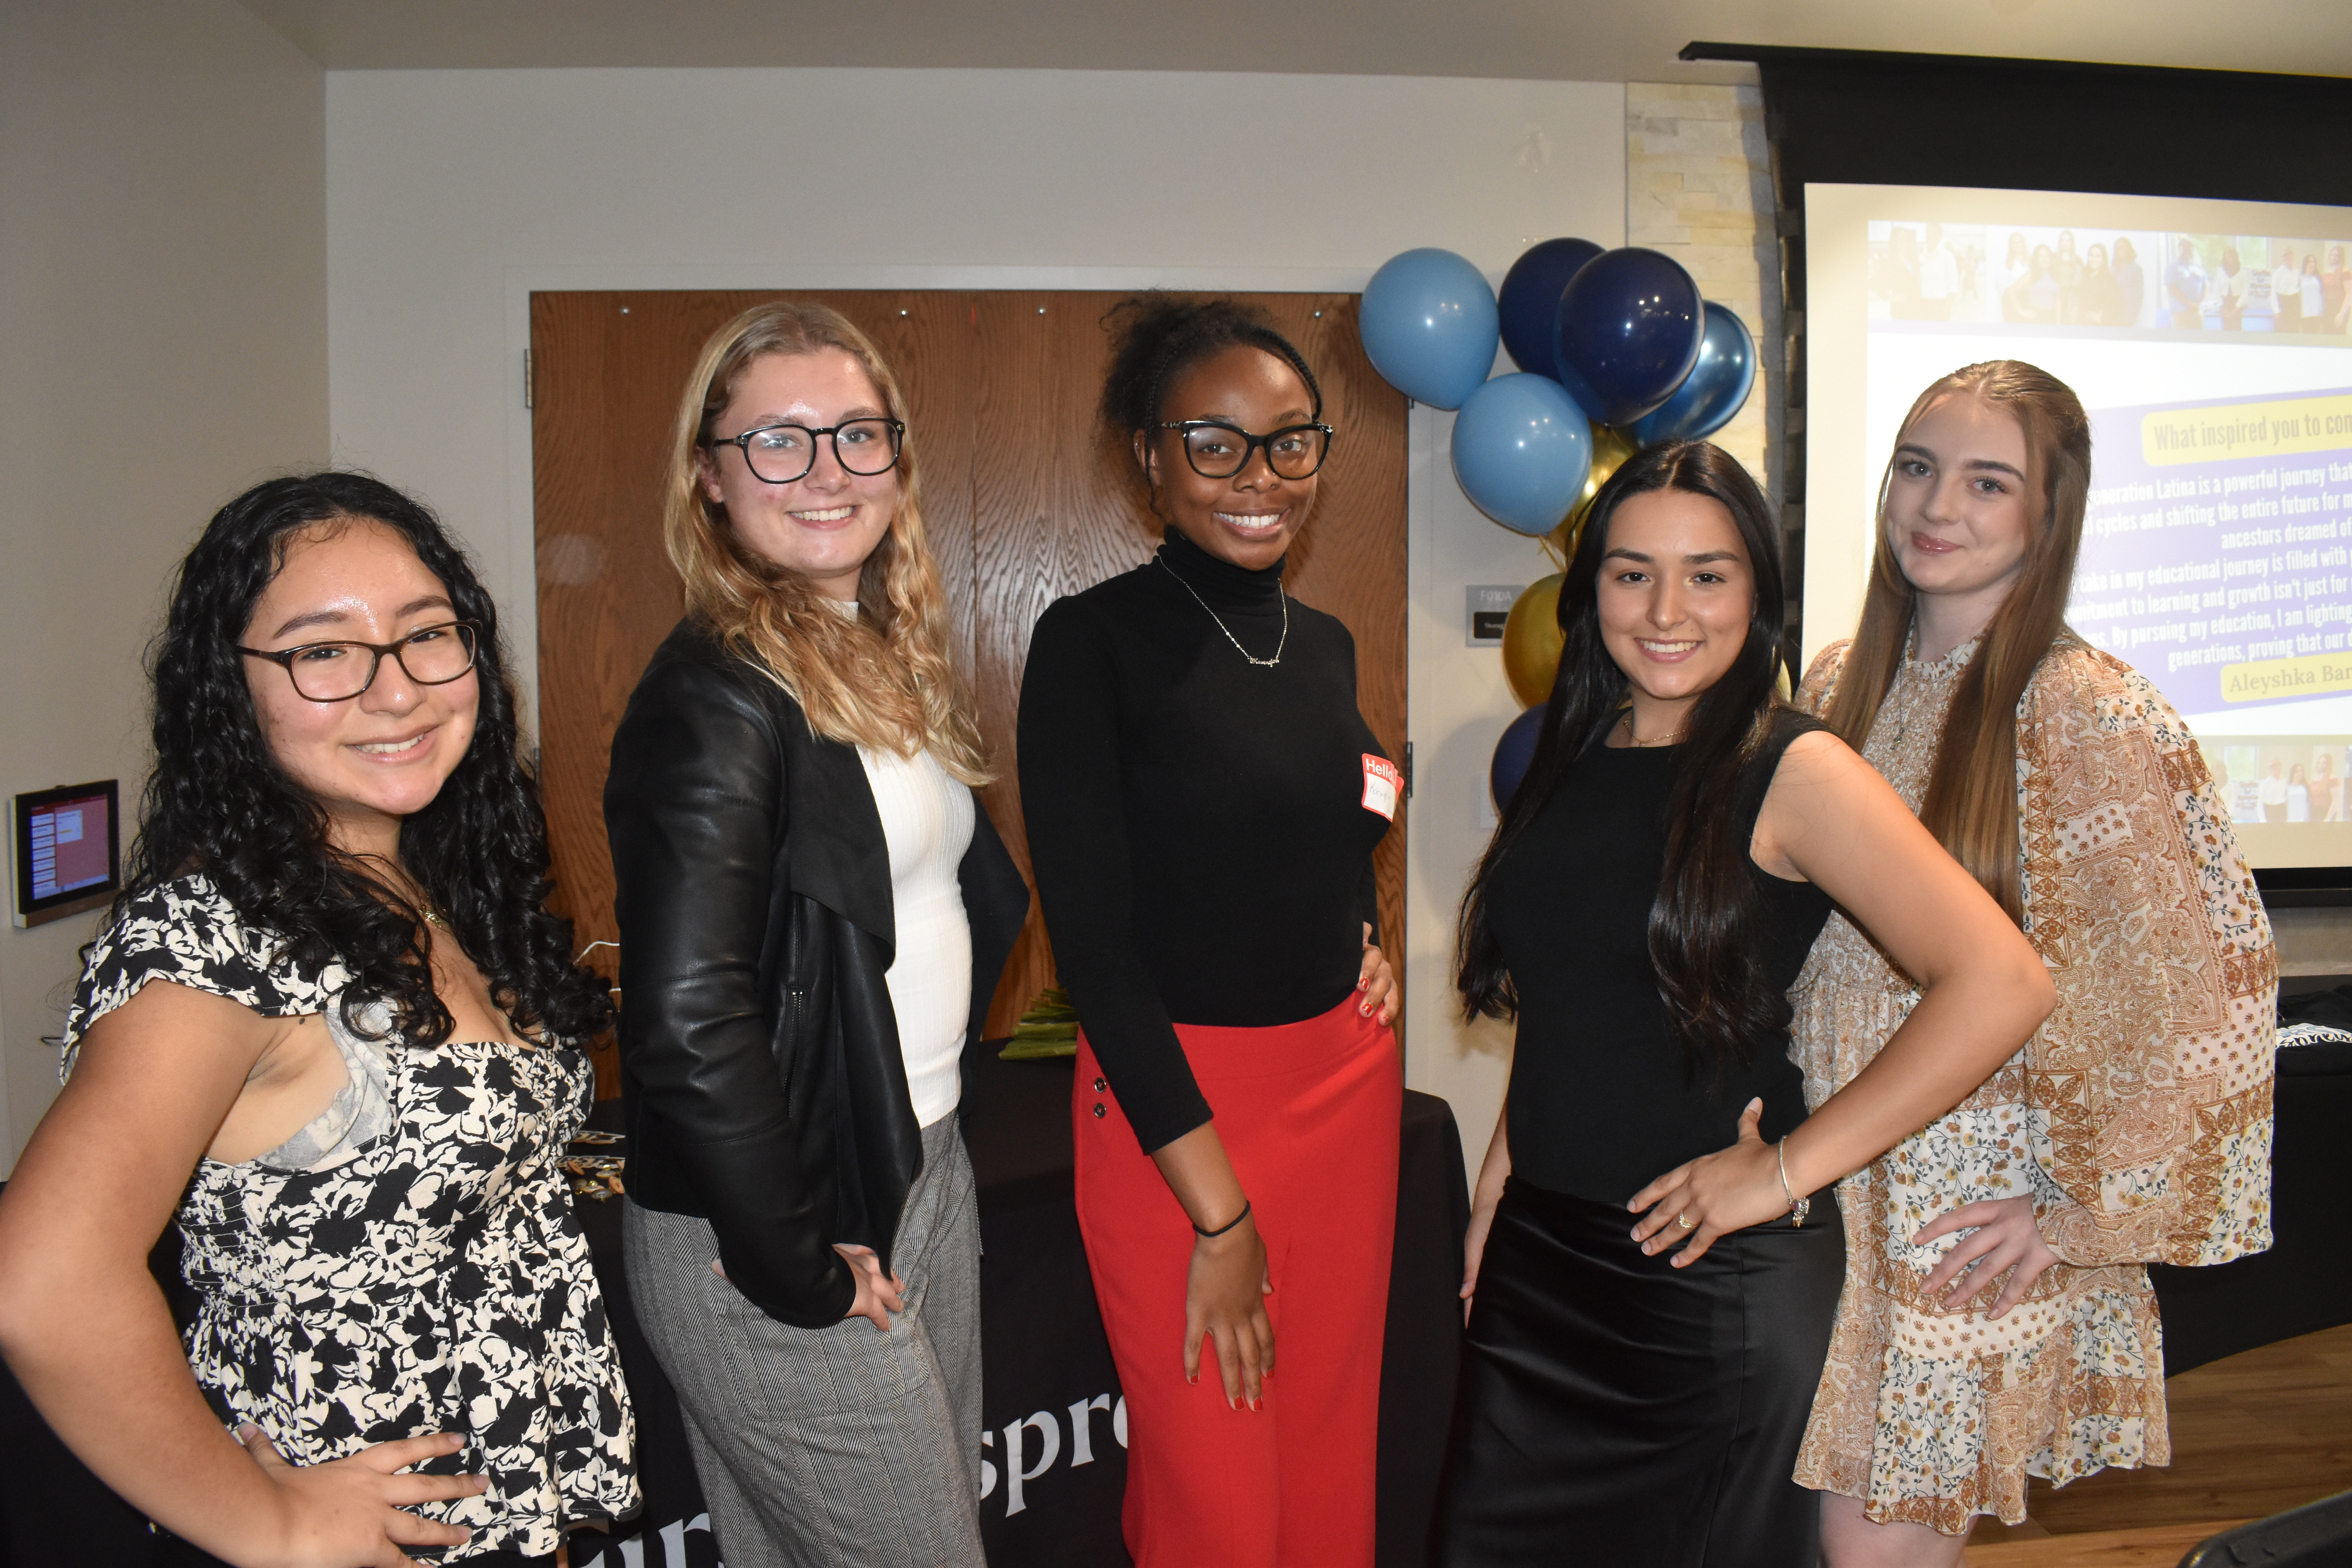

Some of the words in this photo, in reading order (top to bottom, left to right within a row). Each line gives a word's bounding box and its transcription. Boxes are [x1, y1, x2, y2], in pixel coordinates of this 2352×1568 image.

[2154, 424, 2197, 451] What
[2202, 419, 2267, 450] inspired
[2272, 419, 2301, 446] you
[2305, 414, 2320, 437] to
[2156, 478, 2196, 499] Latina
[2198, 475, 2210, 495] is
[2212, 479, 2221, 494] a
[2223, 468, 2277, 497] powerful
[2280, 467, 2325, 491] journey
[2328, 462, 2352, 481] that
[2096, 512, 2137, 538] cycles
[2140, 507, 2163, 529] and
[2166, 503, 2216, 526] shifting
[2218, 501, 2238, 522] the
[2241, 497, 2278, 517] entire
[2281, 494, 2319, 514] future
[2321, 492, 2340, 510] for
[2221, 527, 2282, 550] ancestors
[2284, 520, 2337, 542] dreamed
[2339, 518, 2352, 537] of
[2080, 571, 2107, 592] take
[2109, 570, 2123, 589] in
[2125, 571, 2144, 591] my
[2147, 559, 2220, 584] educational
[2223, 558, 2269, 581] journey
[2272, 553, 2283, 572] is
[2285, 548, 2318, 569] filled
[2319, 545, 2347, 566] with
[2131, 598, 2145, 615] to
[2147, 592, 2200, 613] learning
[2202, 588, 2225, 607] and
[2228, 582, 2270, 609] growth
[2274, 578, 2301, 599] isn't
[2303, 577, 2327, 601] just
[2330, 574, 2348, 593] for
[2111, 626, 2129, 649] By
[2131, 620, 2187, 648] pursuing
[2189, 620, 2207, 639] my
[2210, 612, 2275, 634] education,
[2277, 609, 2281, 627] I
[2285, 610, 2303, 626] am
[2306, 602, 2352, 627] lighting
[2168, 643, 2246, 672] generations,
[2248, 637, 2294, 662] proving
[2296, 633, 2321, 653] that
[2324, 634, 2345, 650] our
[2230, 668, 2316, 694] Aleyshka
[1366, 758, 1392, 780] Hello
